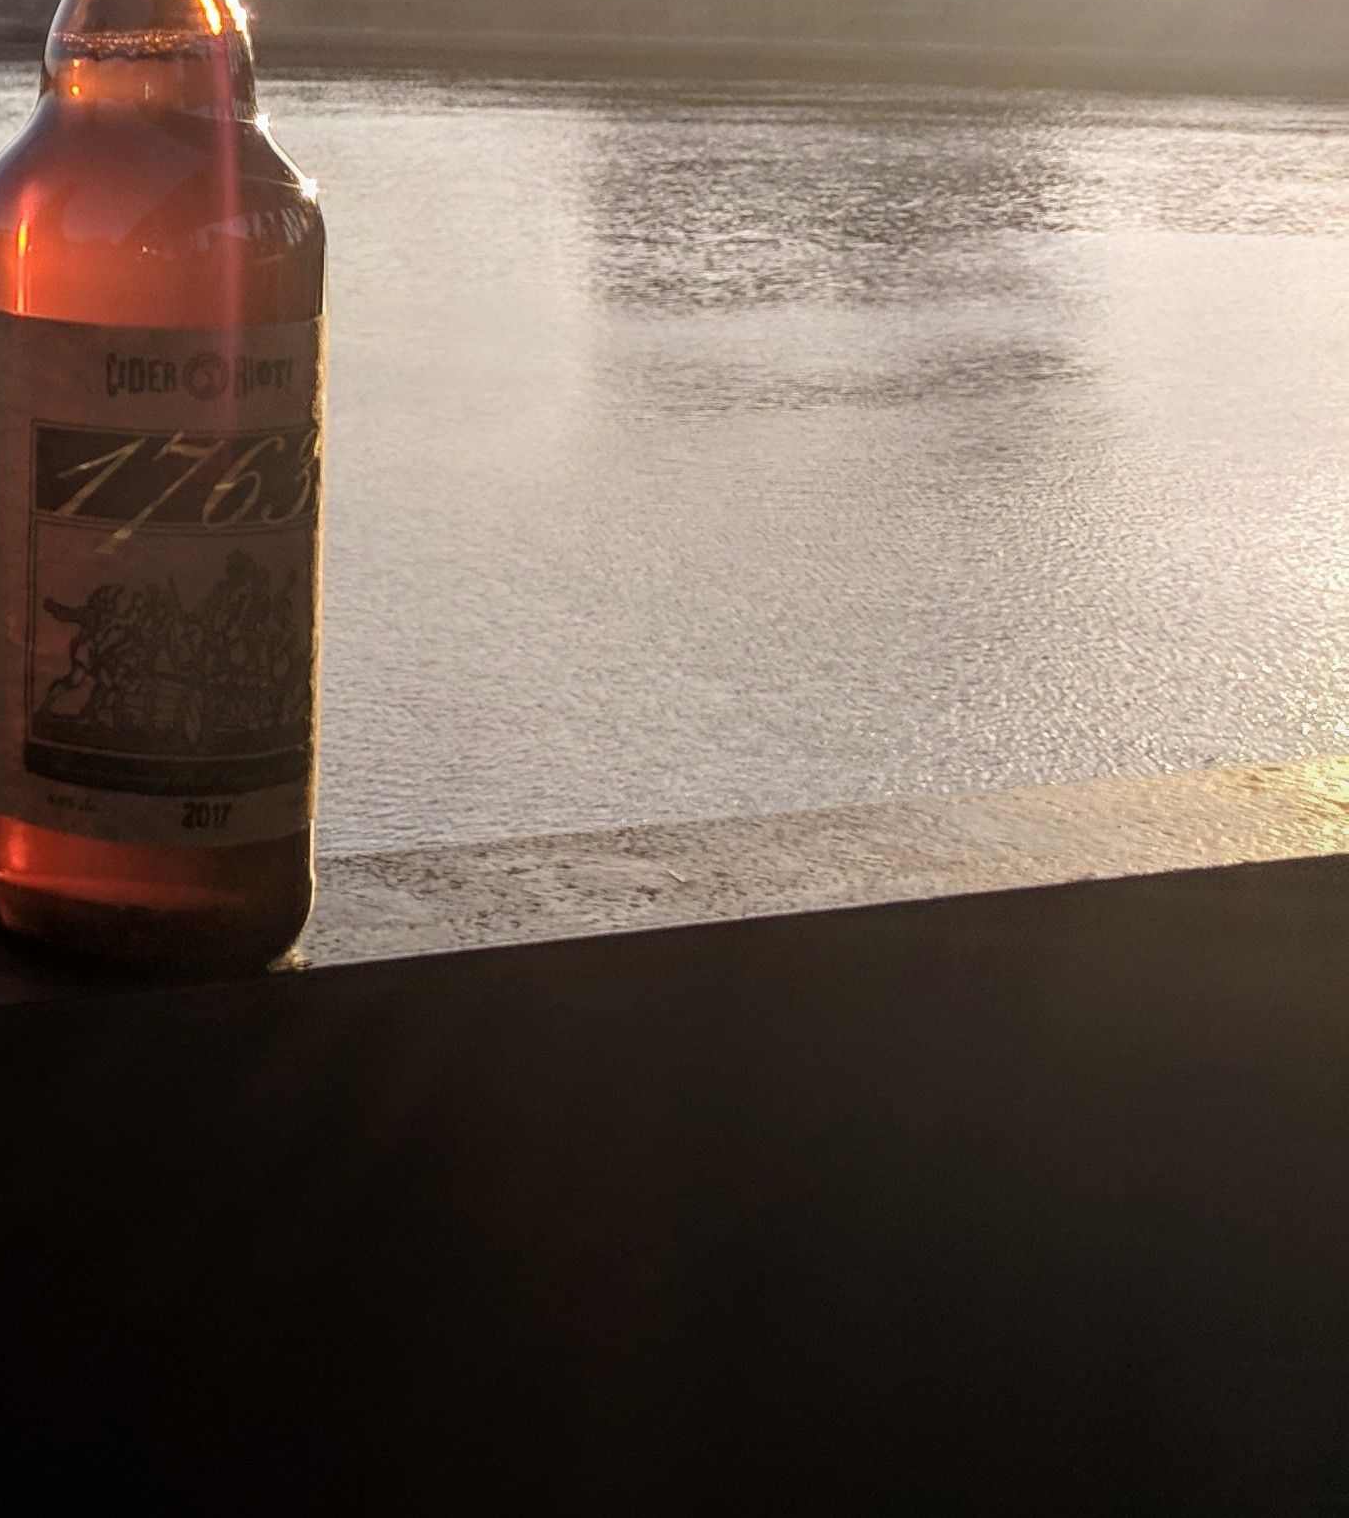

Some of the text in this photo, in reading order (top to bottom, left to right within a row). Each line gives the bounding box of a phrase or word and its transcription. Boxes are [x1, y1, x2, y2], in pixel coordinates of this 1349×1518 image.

[105, 351, 178, 397] CIDER
[56, 429, 318, 555] 1763
[181, 801, 233, 829] 2017
